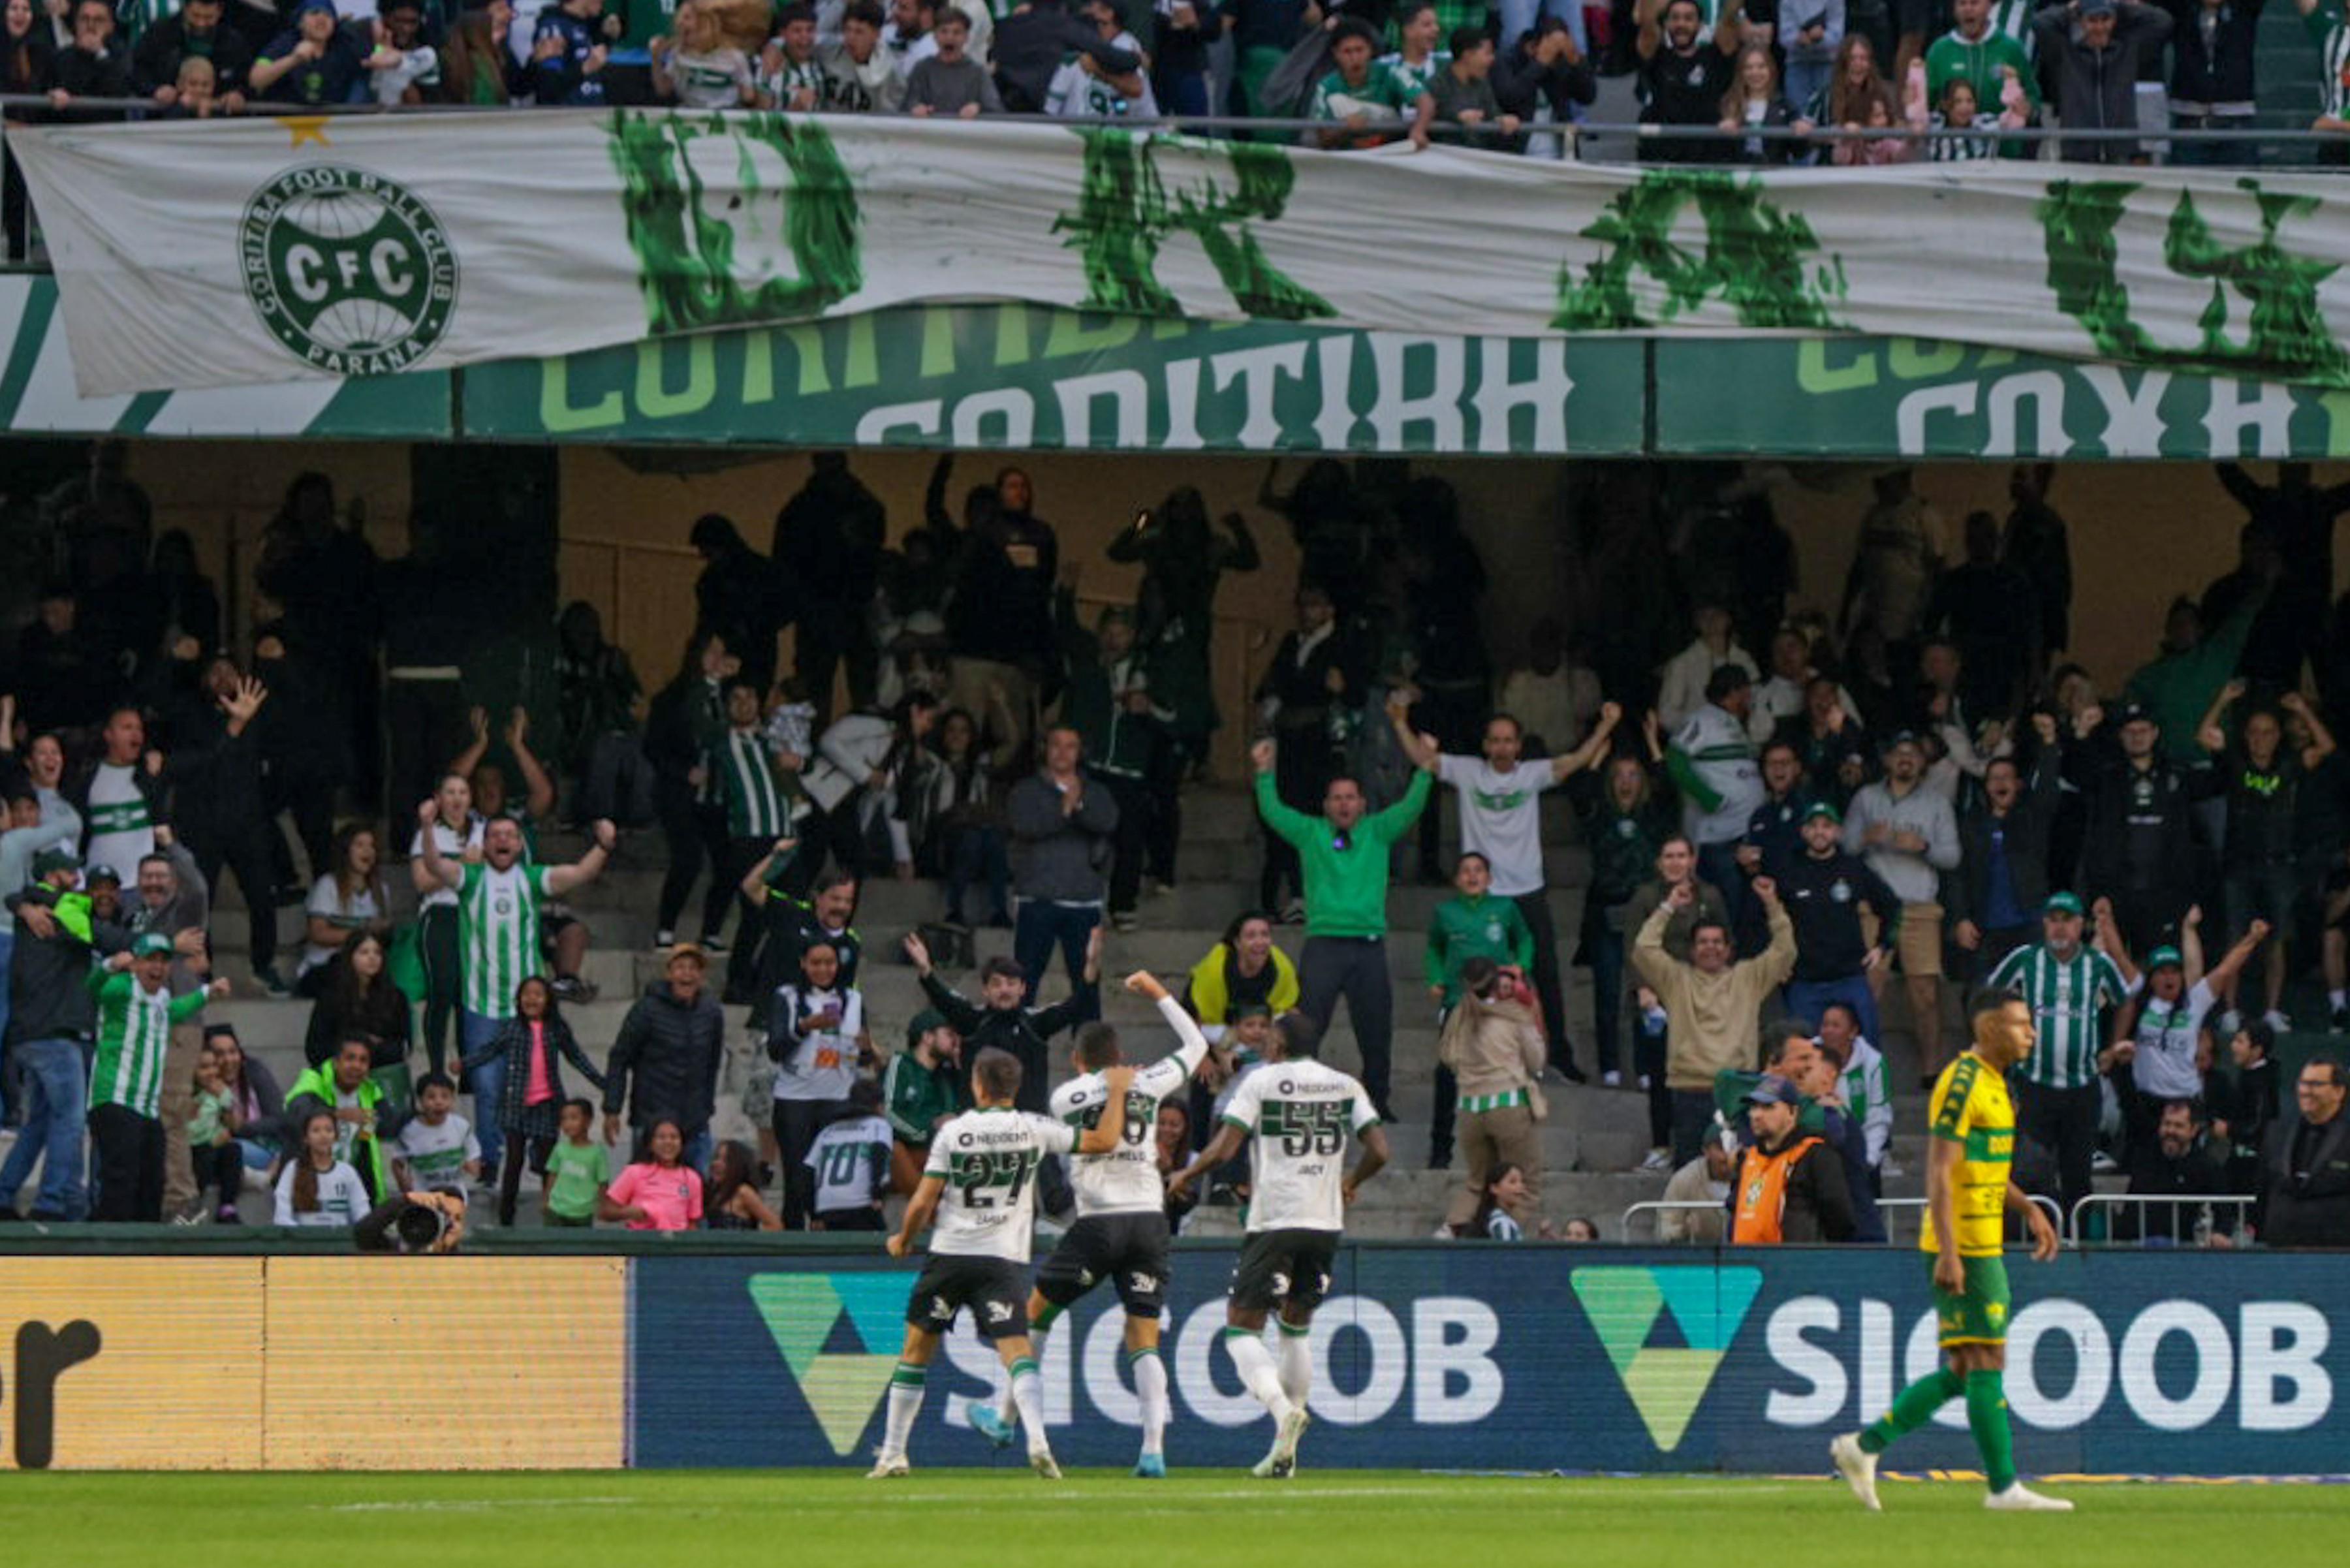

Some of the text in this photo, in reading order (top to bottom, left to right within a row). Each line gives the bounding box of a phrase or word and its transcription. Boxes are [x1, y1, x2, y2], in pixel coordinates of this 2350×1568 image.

[245, 194, 283, 316] CORITIBA
[422, 228, 454, 302] CLUB
[285, 237, 415, 302] CFC
[1282, 1101, 1342, 1157] 55
[962, 1152, 1029, 1208] 27
[0, 1317, 102, 1470] r
[944, 1294, 1505, 1427] SICOOB
